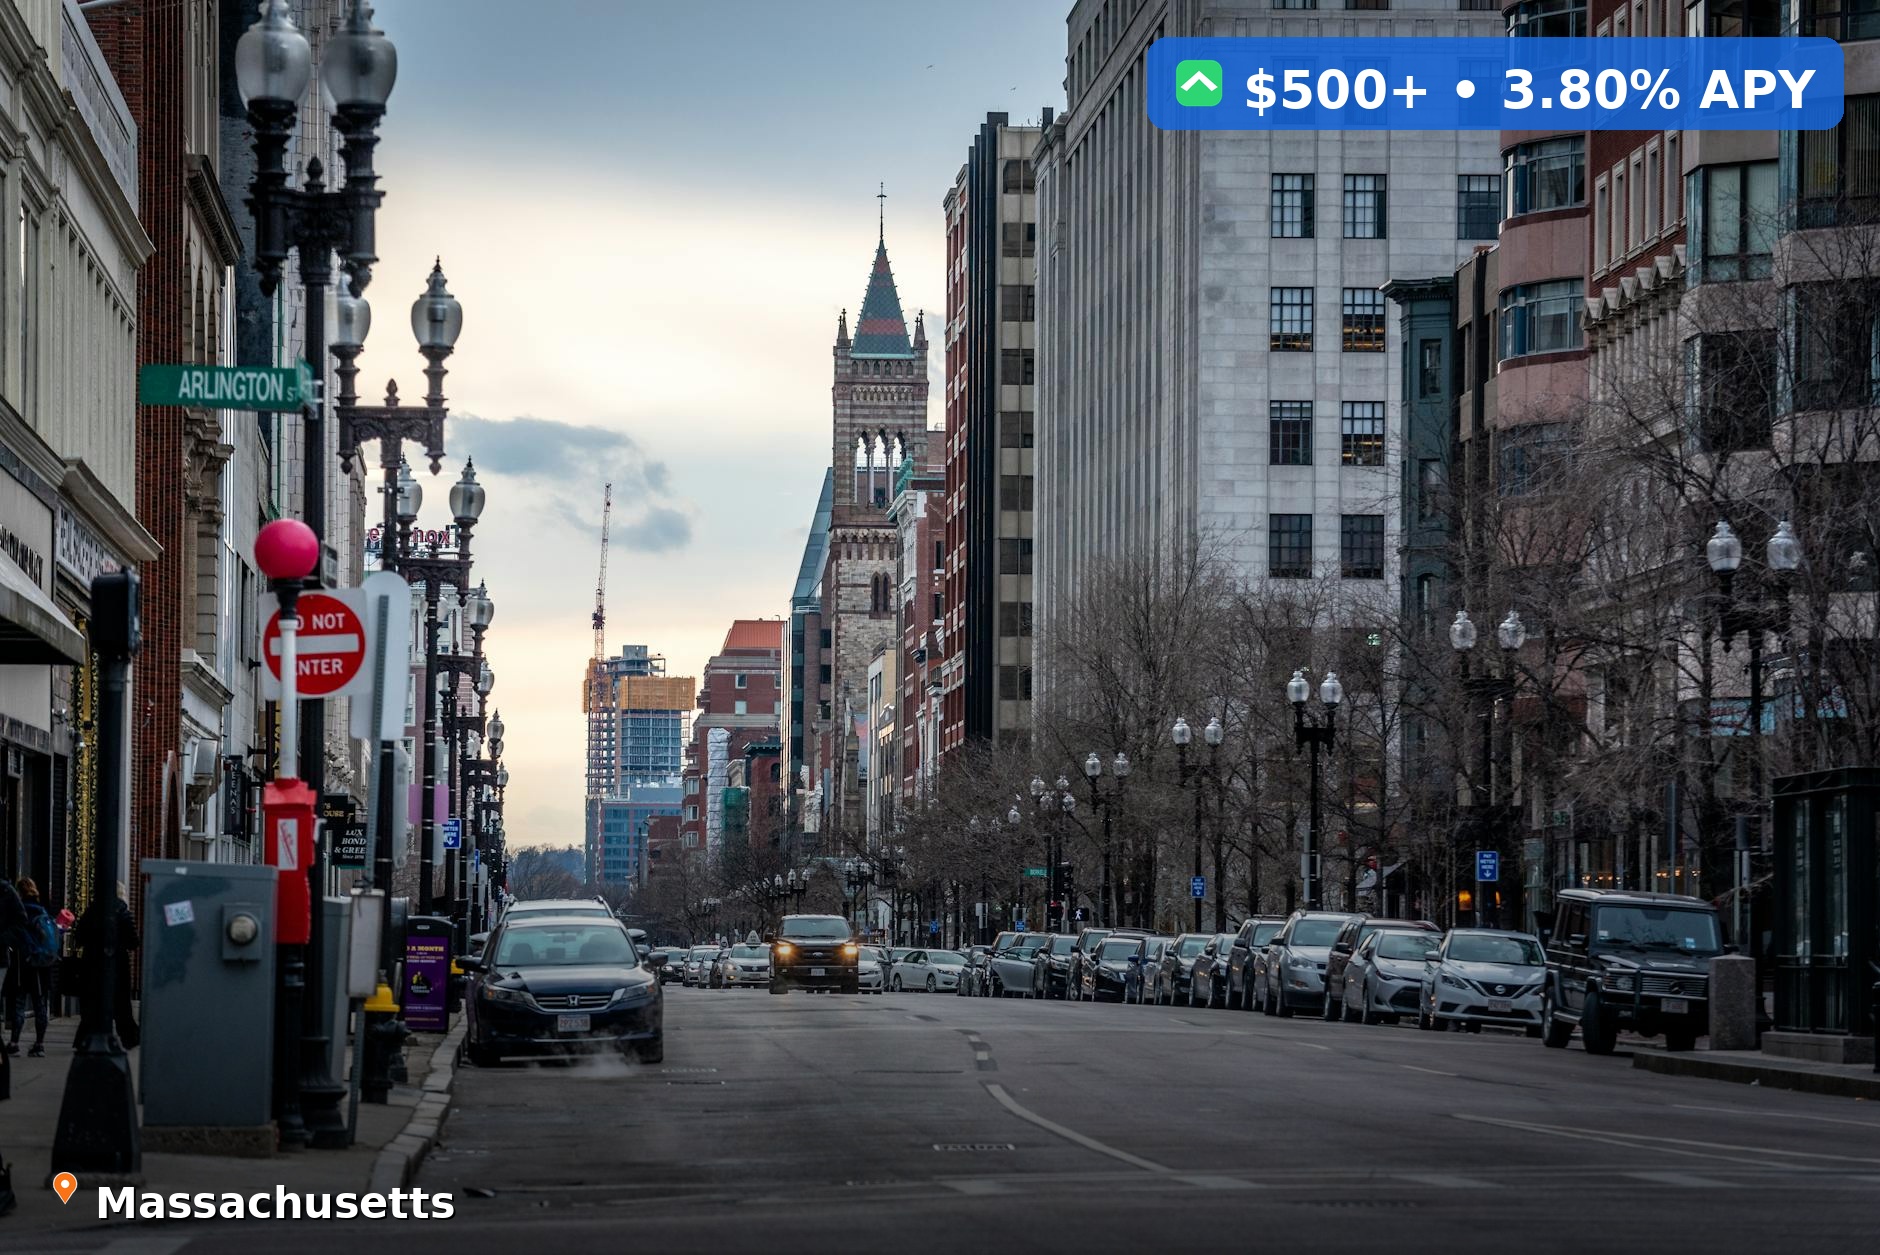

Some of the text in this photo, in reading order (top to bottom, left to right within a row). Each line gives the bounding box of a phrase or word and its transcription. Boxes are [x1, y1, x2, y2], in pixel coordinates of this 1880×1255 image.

[178, 370, 283, 402] ARLINGTON
[312, 613, 345, 630] NOT
[297, 658, 343, 675] NTER
[342, 846, 367, 854] GREE
